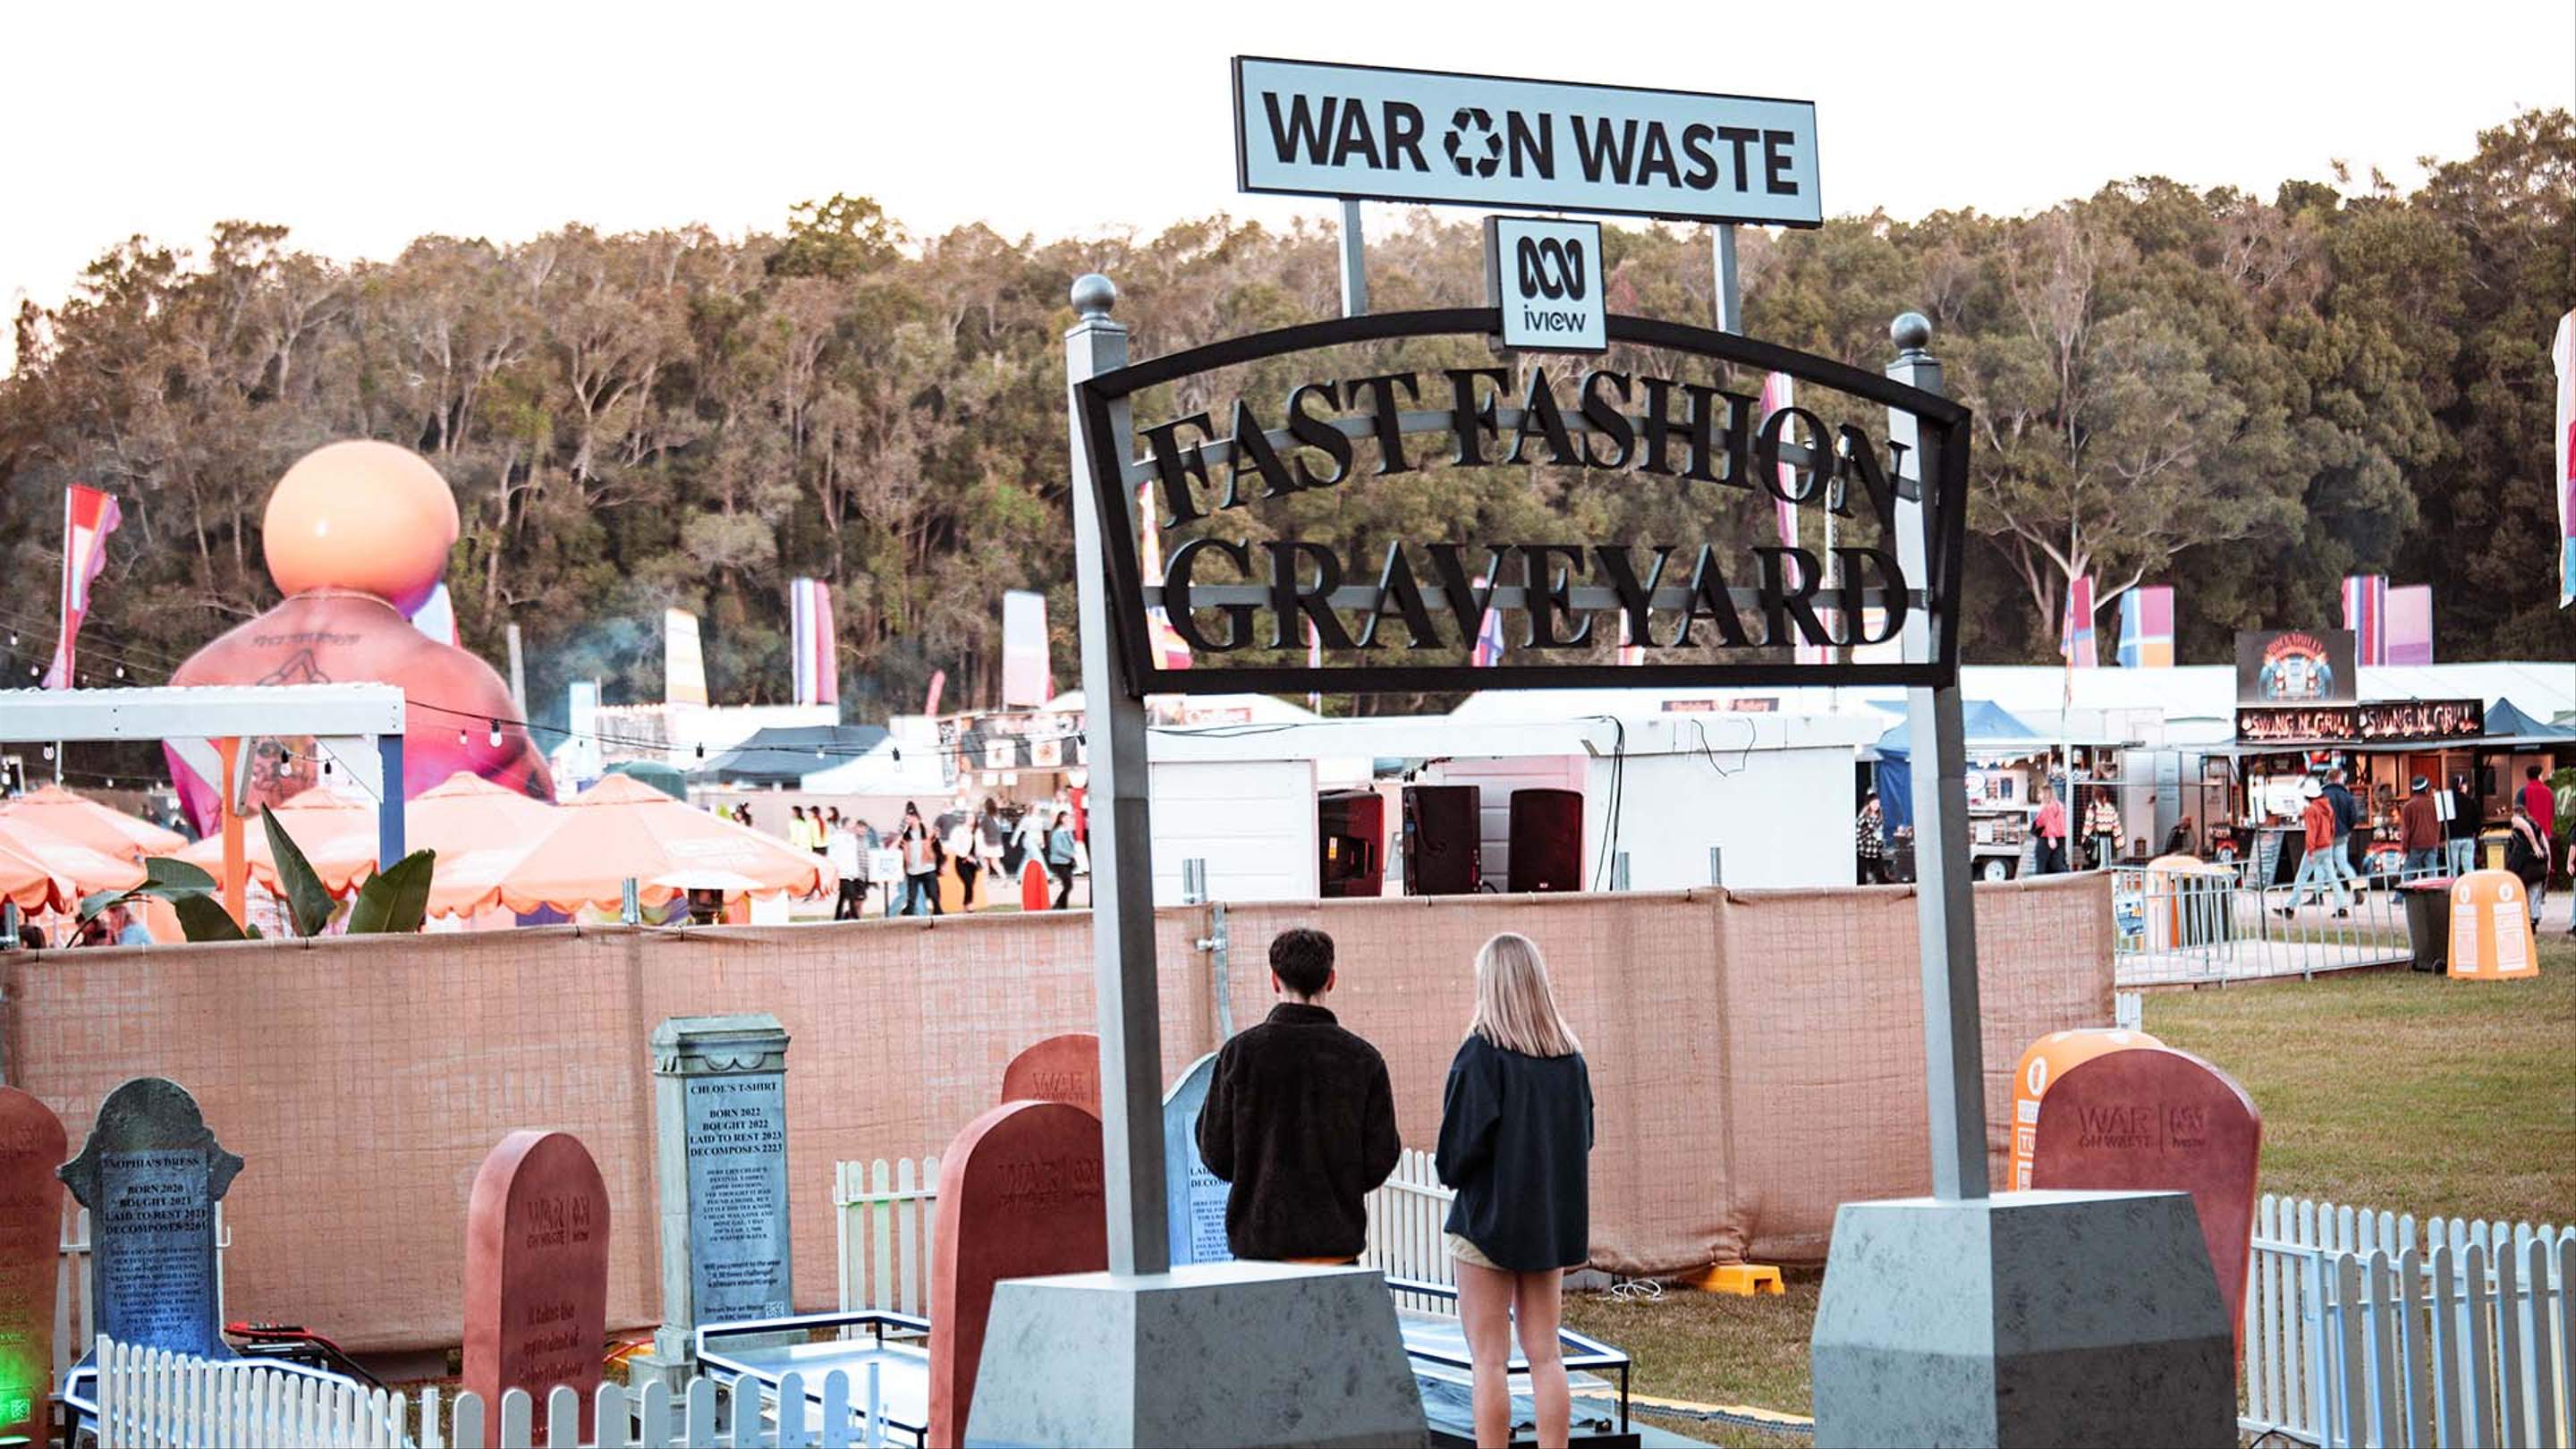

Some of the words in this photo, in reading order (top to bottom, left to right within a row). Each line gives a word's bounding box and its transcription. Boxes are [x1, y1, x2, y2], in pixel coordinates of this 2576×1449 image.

[1261, 91, 1431, 173] WAR
[1570, 115, 1800, 196] WASTE
[1523, 303, 1586, 333] iview
[1138, 370, 1420, 528] FAST
[1445, 365, 1912, 530] FASHION
[1165, 537, 1910, 654] GRAVEYARD
[691, 1084, 736, 1095] CHLOE'S
[739, 1082, 776, 1092] T-SHIRT
[709, 1109, 738, 1118] BORN
[741, 1107, 760, 1116] 2022
[702, 1121, 745, 1131] BOUGHT
[749, 1119, 768, 1129] 2022
[2079, 1106, 2150, 1134] WAR
[691, 1135, 715, 1144] LAID
[718, 1134, 732, 1142] TO
[733, 1132, 758, 1141] REST
[762, 1131, 782, 1140] 2023
[691, 1146, 760, 1157] DECOMPOSES
[762, 1143, 782, 1153] 2223
[110, 1159, 161, 1169] SOPHIA'S
[164, 1157, 199, 1167] DRESS
[128, 1185, 158, 1194] BORN
[120, 1198, 165, 1208] BOUGHT
[106, 1213, 133, 1222] LAID
[137, 1212, 151, 1220] TO
[153, 1210, 181, 1219] REST
[106, 1223, 183, 1234] DECOMPOSES
